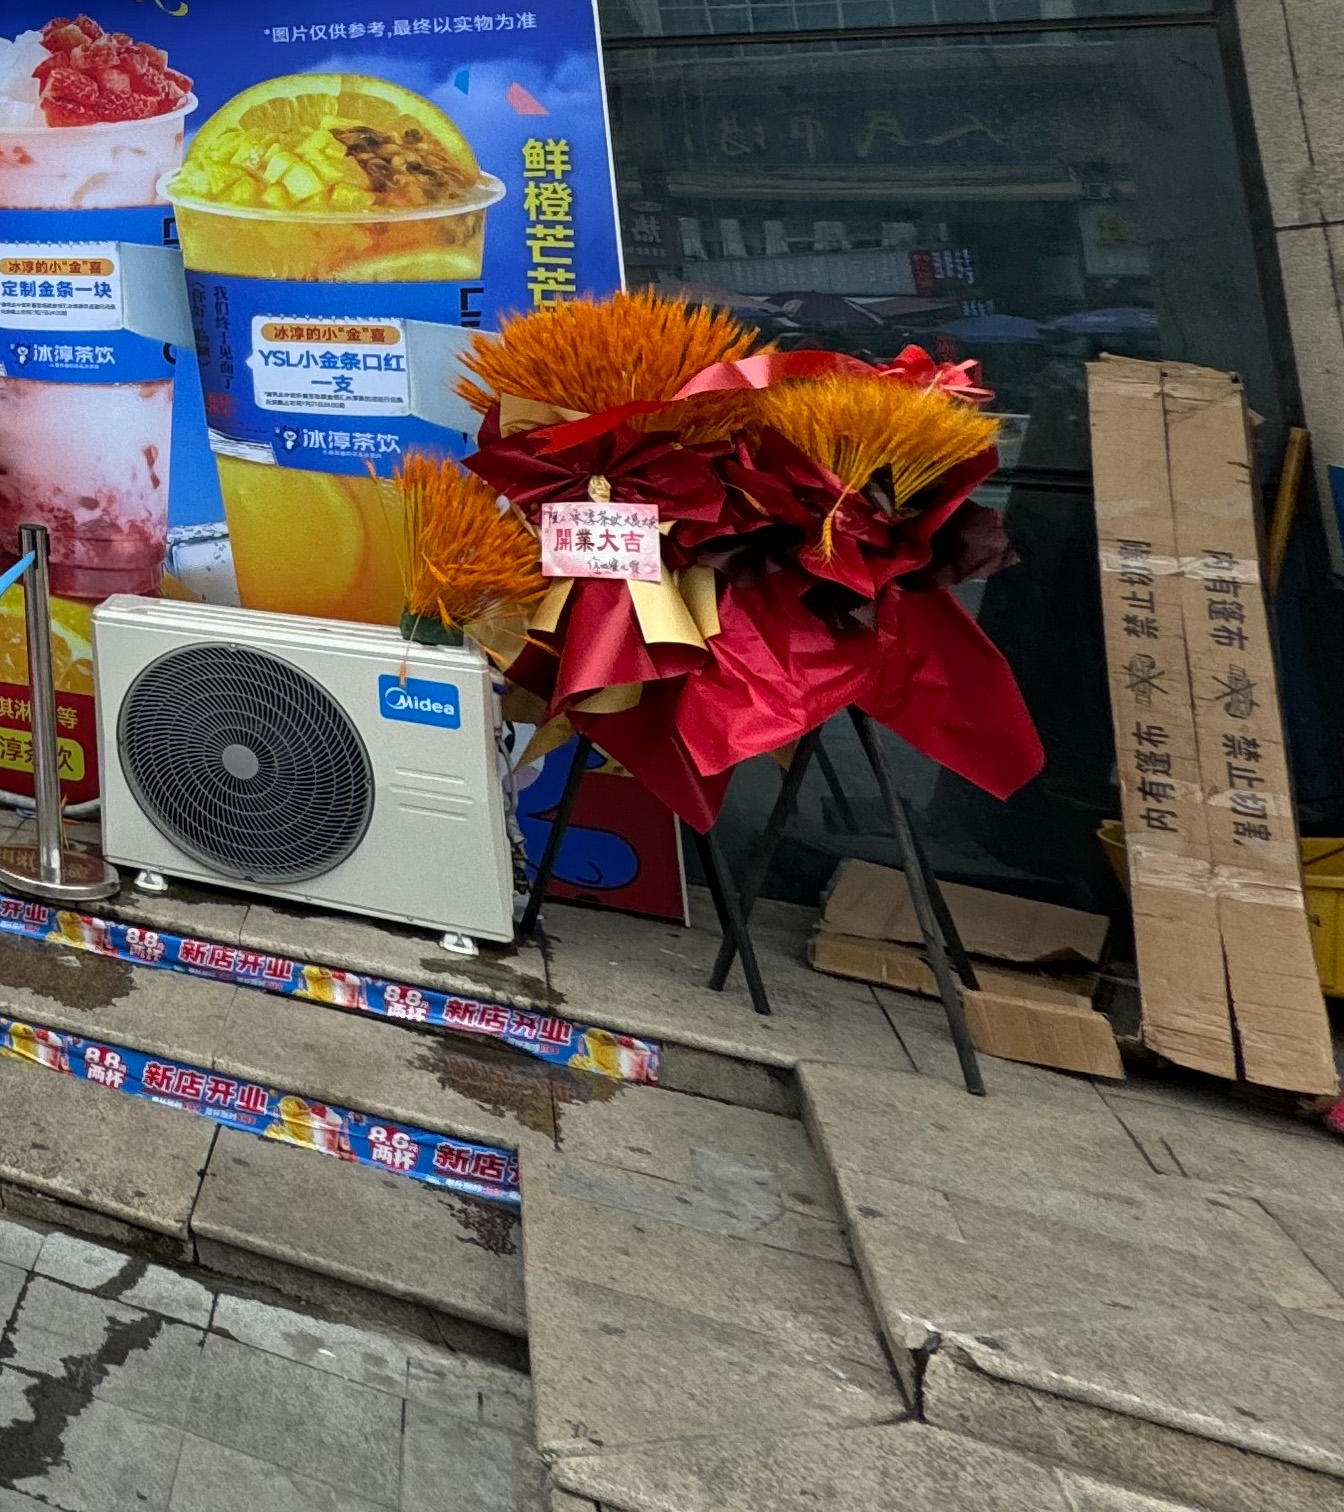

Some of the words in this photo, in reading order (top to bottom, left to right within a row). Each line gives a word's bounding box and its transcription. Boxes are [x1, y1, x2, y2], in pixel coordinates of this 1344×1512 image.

[0, 281, 113, 299] 定制金条一块
[33, 344, 116, 365] 冰淳茶饮
[258, 350, 406, 373] YSL小金条口红
[310, 375, 355, 395] 一支
[303, 428, 402, 455] 冰淳茶饮
[554, 529, 645, 554] 開業大吉
[384, 686, 455, 717] Midea
[179, 939, 294, 982] 新店开业
[443, 997, 573, 1047] 新店开业
[86, 1063, 126, 1089] 两杯
[142, 1061, 269, 1116] 新店开业
[372, 1143, 416, 1172] 两杯
